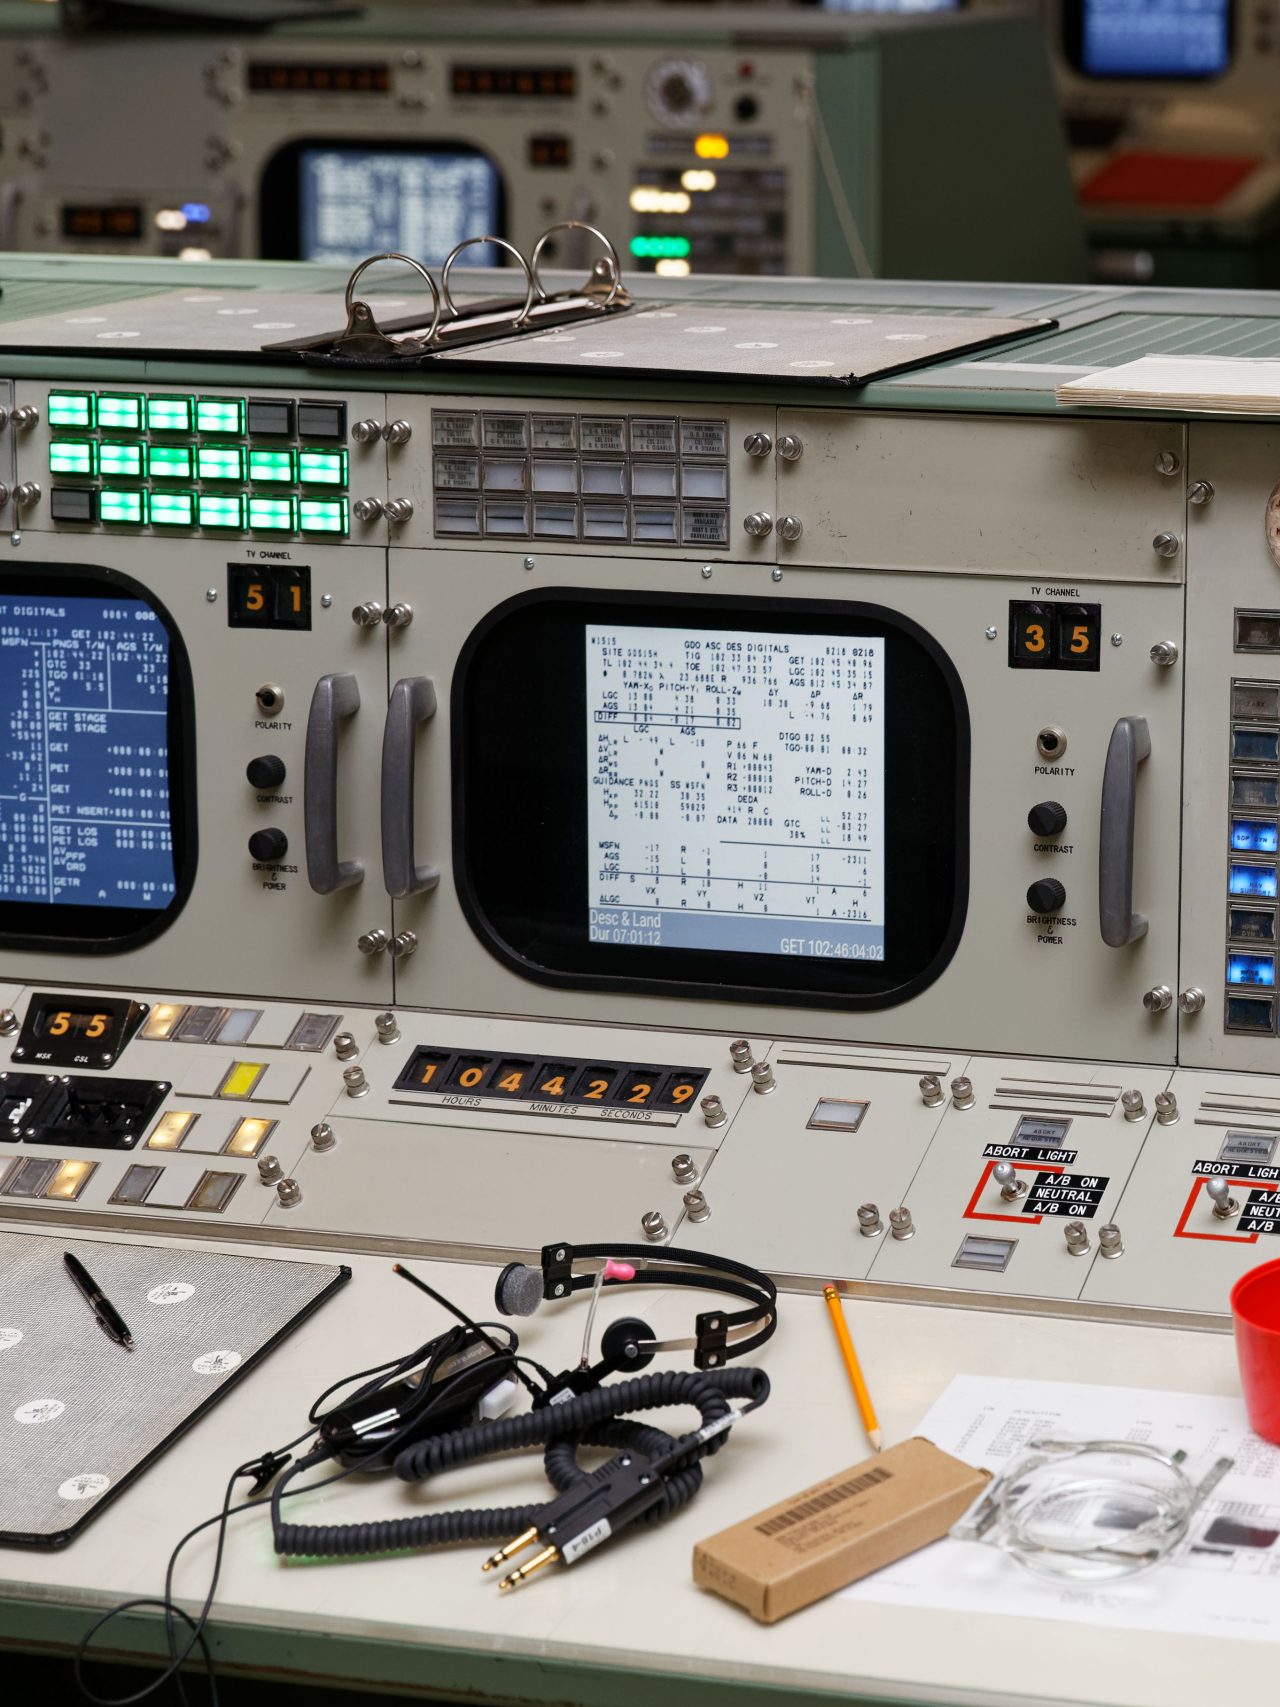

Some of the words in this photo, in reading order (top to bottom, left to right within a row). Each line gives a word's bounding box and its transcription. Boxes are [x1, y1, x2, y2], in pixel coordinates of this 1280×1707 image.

[247, 551, 256, 559] TV
[259, 551, 292, 560] CHANNEL
[1031, 587, 1041, 596] TV
[1045, 588, 1080, 597] CHANNEL
[14, 606, 65, 617] DIGITALS
[72, 630, 91, 638] GET
[86, 641, 104, 649] T/M
[117, 642, 137, 650] AGS
[144, 643, 163, 651] T/M
[706, 642, 721, 650] ASC
[727, 643, 742, 651] DES
[748, 644, 789, 653] DIGITALS
[602, 648, 622, 656] SITE
[686, 652, 700, 660] TIG
[686, 663, 700, 671] TOE
[789, 668, 805, 676] LGC
[48, 671, 67, 679] TGO
[789, 679, 805, 687] AGS
[49, 713, 68, 721] GET
[74, 714, 107, 722] STAGE
[598, 712, 618, 720] DIFF
[49, 723, 68, 731] PET
[75, 724, 107, 733] STAGE
[255, 721, 292, 730] POLARITY
[634, 725, 649, 733] LGC
[780, 732, 800, 741] DTGO
[49, 743, 69, 752] GET
[50, 764, 69, 772] PET
[1034, 767, 1075, 776] POLARITY
[593, 777, 634, 786] GUIDANCE
[795, 777, 832, 786] PITCH-D
[51, 785, 70, 793] GET
[800, 788, 832, 796] ROLL-D
[256, 795, 293, 804] CONTRAST
[51, 806, 70, 814] PET
[52, 826, 71, 834] GET
[78, 828, 98, 836] LOS
[78, 838, 98, 846] LOS
[1034, 845, 1073, 853] CONTRAST
[252, 863, 298, 873] BRIGHTNESS
[53, 878, 80, 886] GETR
[263, 881, 286, 890] POWER
[590, 909, 618, 925] Desc
[622, 912, 630, 925] &
[633, 912, 661, 928] Land
[1027, 916, 1076, 926] BRIGHTNESS
[590, 926, 610, 939] Dur
[613, 929, 660, 944] 07:01:12
[781, 939, 805, 953] GET
[808, 941, 883, 958] 102:46:04:02
[1038, 936, 1063, 945] POWER
[442, 1097, 482, 1106] HOURS
[530, 1103, 579, 1115] MINUTES
[601, 1109, 652, 1120] SECONDS
[984, 1146, 1029, 1158] ABORT
[1038, 1151, 1076, 1162] LIGHT
[1193, 1162, 1239, 1174] ABORT
[1045, 1176, 1071, 1185] A/B
[1081, 1178, 1098, 1188] ON
[1036, 1188, 1092, 1202] NEUTRAL
[1033, 1203, 1059, 1213] A/B
[1069, 1205, 1087, 1215] ON
[1248, 1221, 1274, 1231] A/B
